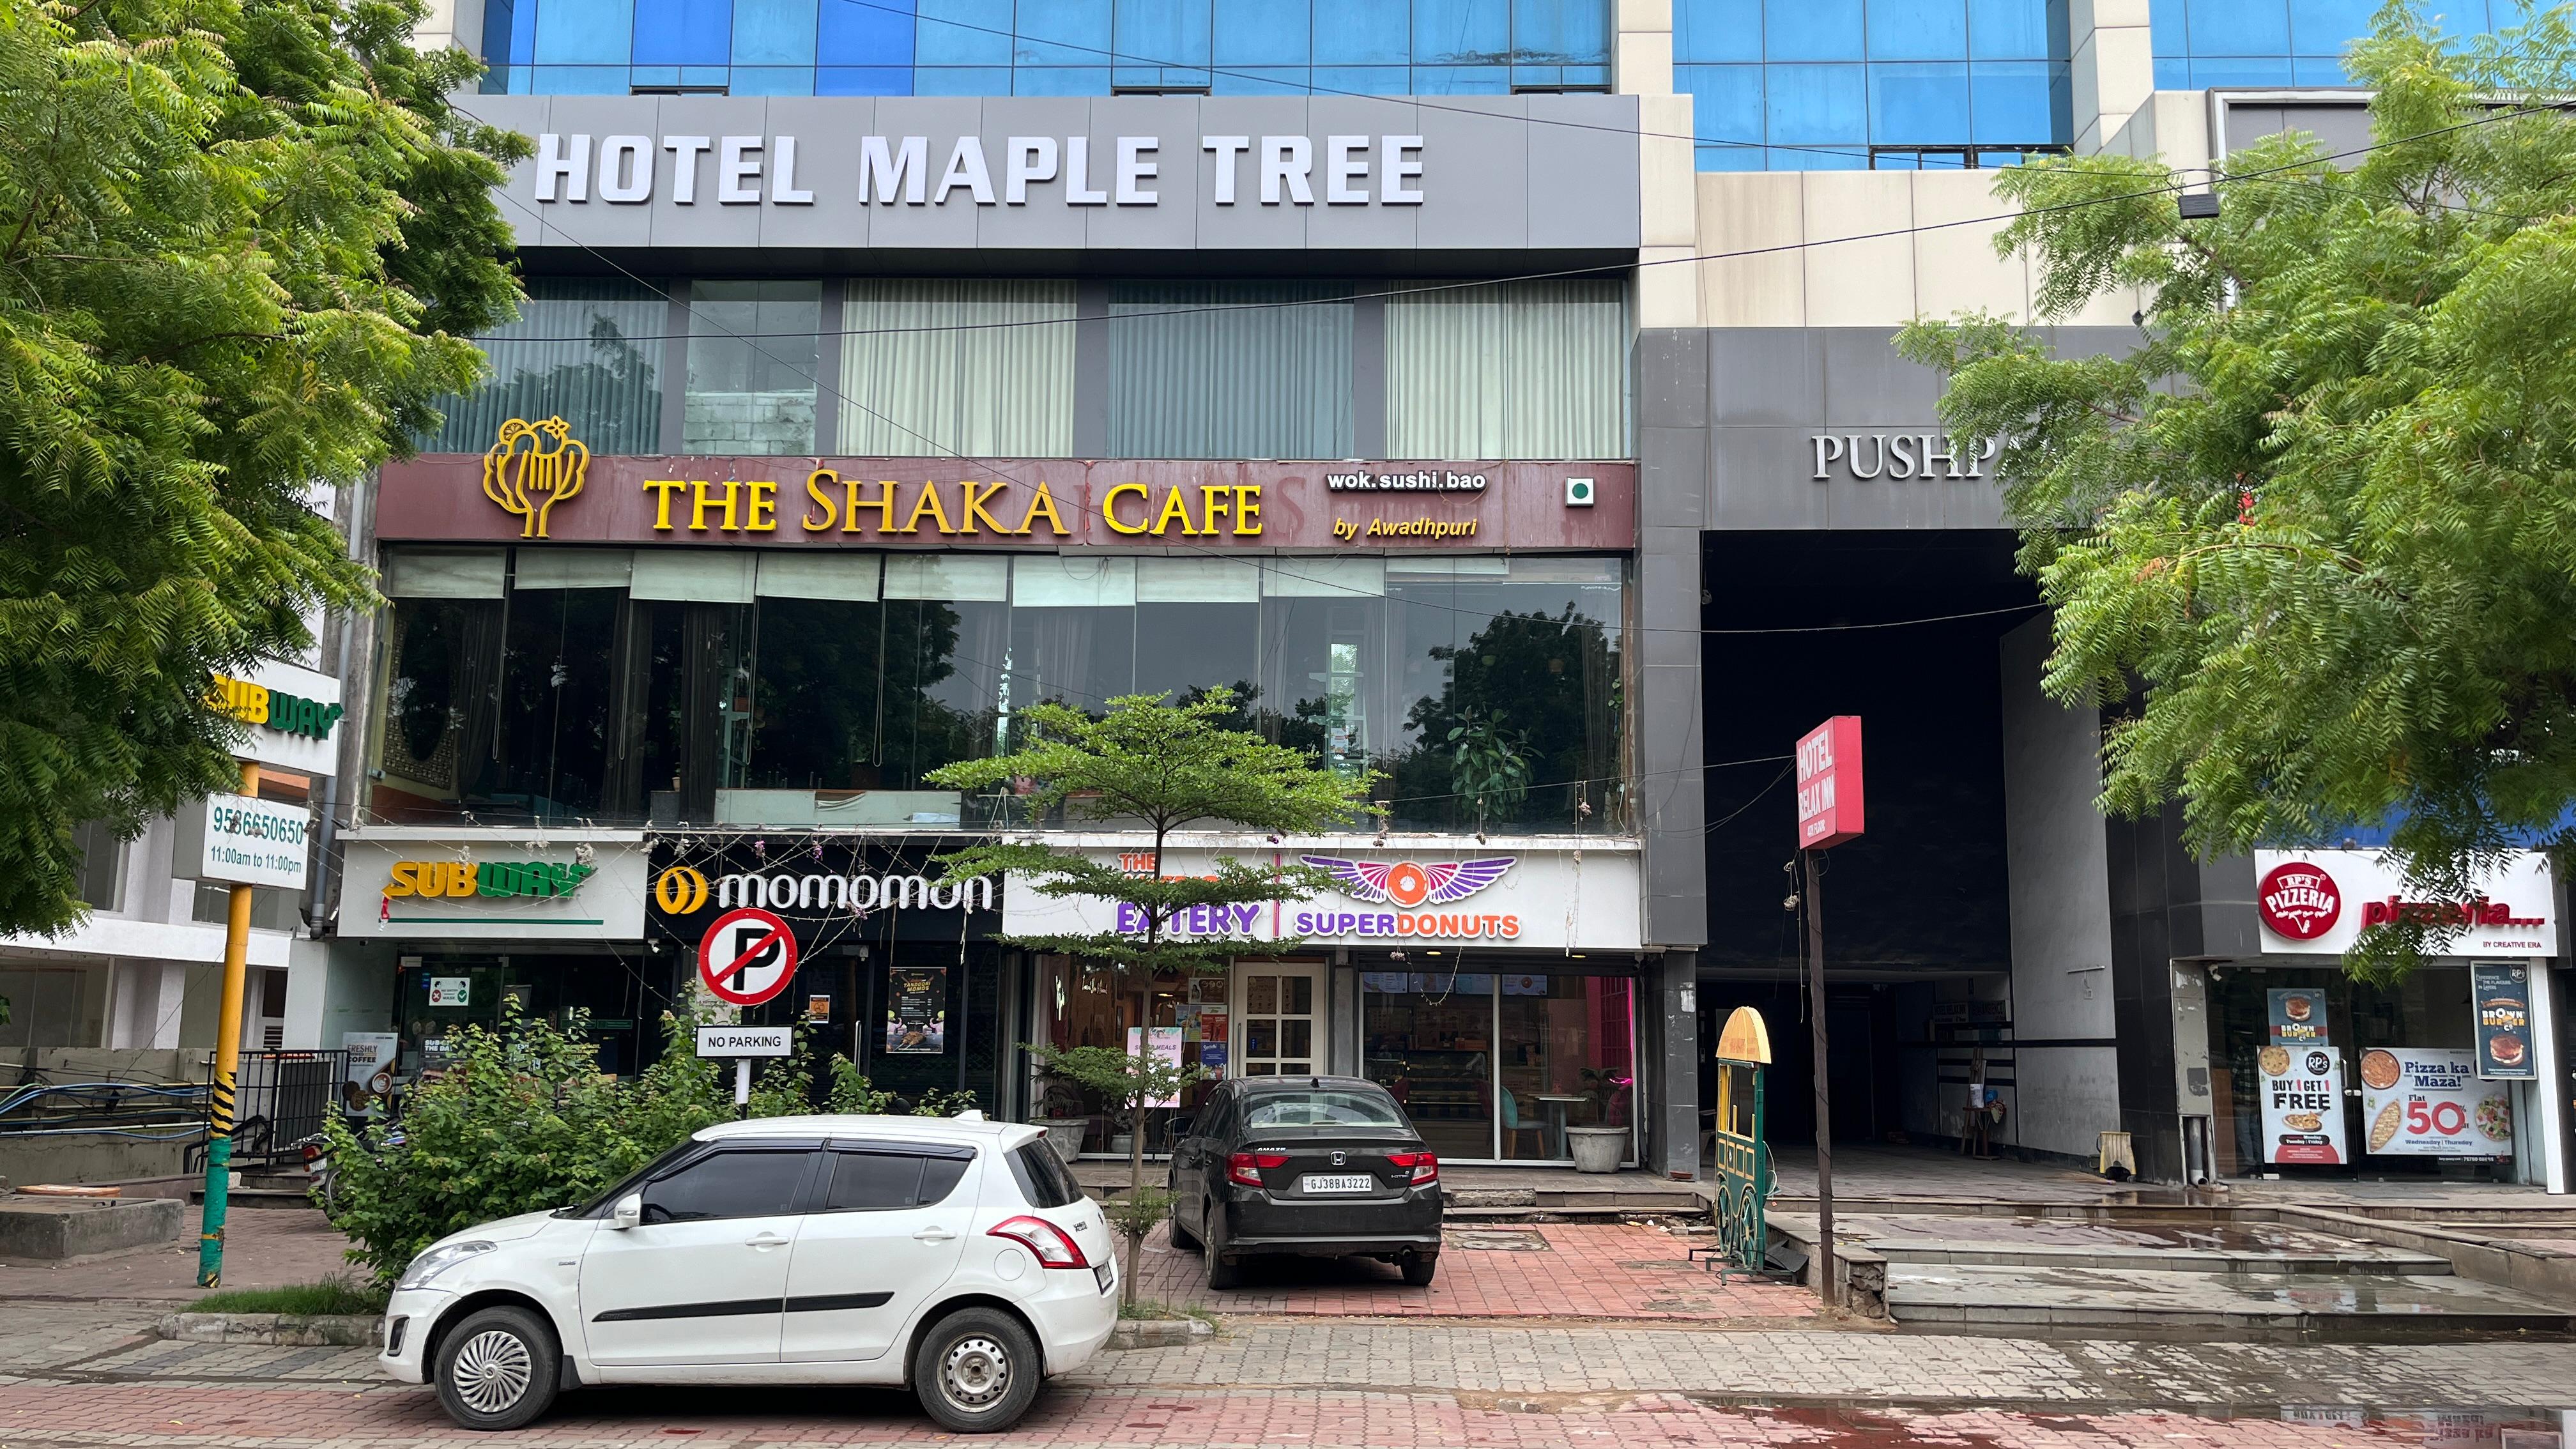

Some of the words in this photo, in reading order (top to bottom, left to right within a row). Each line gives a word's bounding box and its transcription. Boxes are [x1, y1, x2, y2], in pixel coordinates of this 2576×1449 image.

[535, 133, 814, 205] HOTEL
[859, 135, 1158, 206] MAPLE
[1202, 135, 1423, 205] TREE
[1811, 434, 2057, 479] PUSHP
[1326, 471, 1487, 490] wok.sushi.bao
[643, 480, 778, 532] THE
[802, 469, 1071, 535] SHAKA
[1103, 482, 1262, 535] CAFE
[1333, 518, 1358, 540] by
[1367, 518, 1478, 540] Awadhpuri
[203, 674, 344, 740] SUBWAY
[1798, 729, 1833, 784] HOTEL
[1798, 781, 1821, 824] RELAX
[1821, 774, 1835, 812] INN
[211, 845, 250, 866] 11:00am
[253, 852, 263, 868] to
[265, 854, 302, 875] 11:00pm
[1119, 854, 1158, 871] THE
[381, 861, 599, 899] SUBWAY
[2286, 876, 2312, 886] RP'S
[718, 873, 993, 910] momomon
[2265, 888, 2334, 914] PIZZERIA
[1296, 912, 1519, 936] SUPERDONUTS
[2482, 1008, 2523, 1019] BROWN
[2483, 1018, 2526, 1026] BURER
[2281, 1023, 2315, 1032] BROWN
[348, 1045, 378, 1054] FRESHLY
[709, 1037, 725, 1048] NO
[729, 1036, 781, 1048] PARKING
[2404, 1061, 2446, 1073] Pizza
[2450, 1061, 2470, 1073] ka
[2272, 1080, 2293, 1091] BUY
[2296, 1079, 2302, 1091] 1
[2303, 1080, 2322, 1092] GET
[2324, 1079, 2330, 1091] 1
[2414, 1075, 2462, 1087] Maza!
[2273, 1093, 2331, 1110] FREE
[2407, 1101, 2465, 1135] 50
[1310, 1177, 1370, 1190] GJ38BA3222
